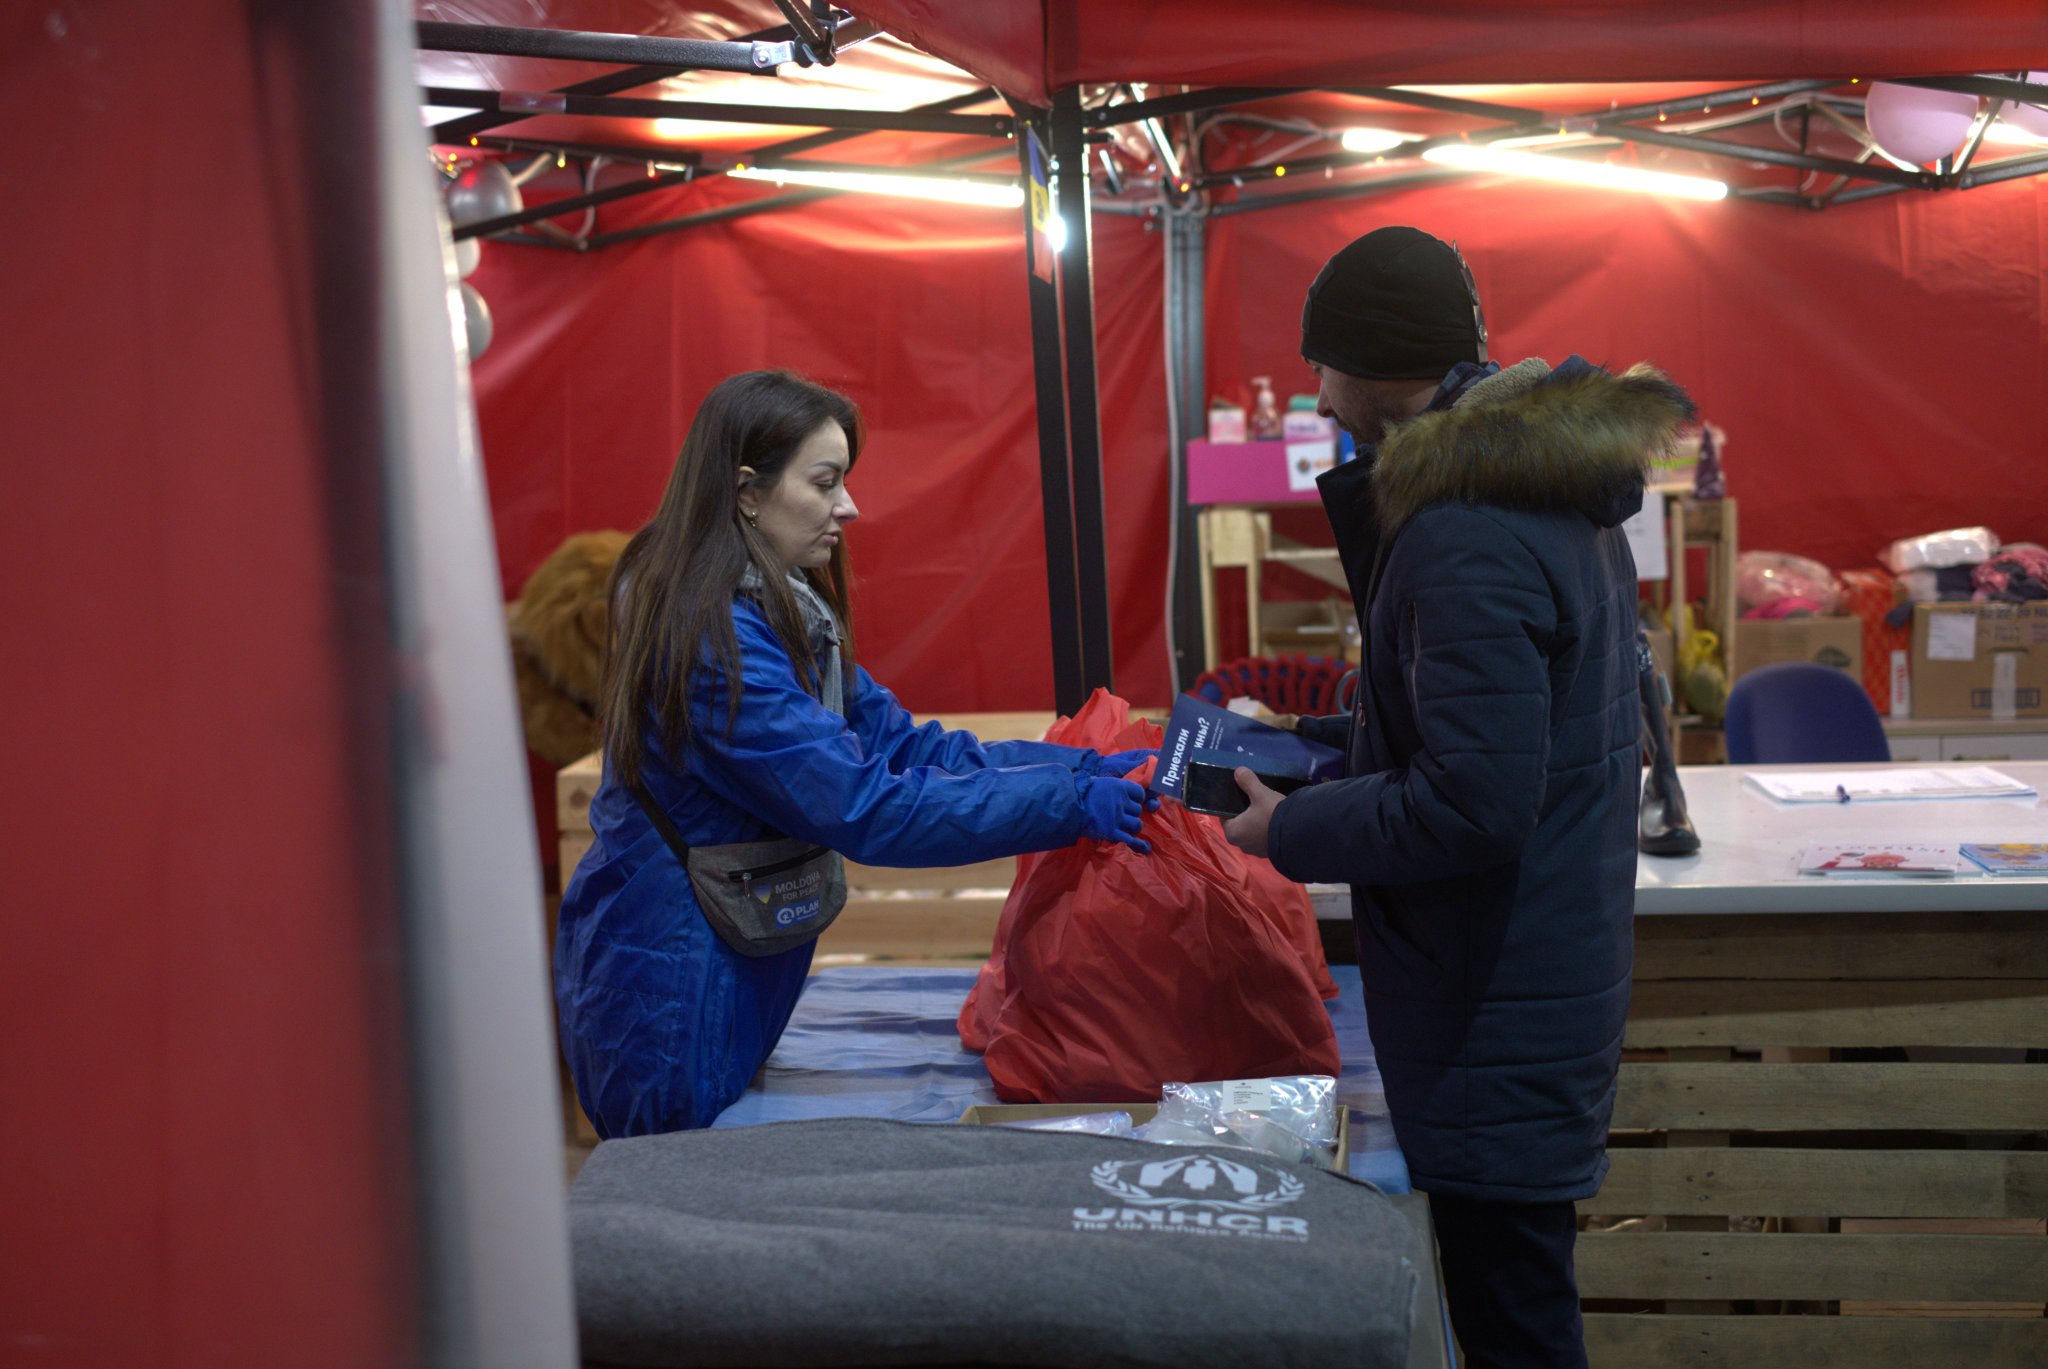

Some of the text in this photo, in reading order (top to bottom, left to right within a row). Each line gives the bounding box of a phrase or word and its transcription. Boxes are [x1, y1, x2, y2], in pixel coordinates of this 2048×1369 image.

[1161, 727, 1190, 788] Приехали
[775, 870, 821, 894] MOLDOVA
[782, 890, 798, 901] FOR
[1071, 1220, 1108, 1232] The
[1114, 1221, 1144, 1232] UN
[1072, 1207, 1310, 1235] UNHCR
